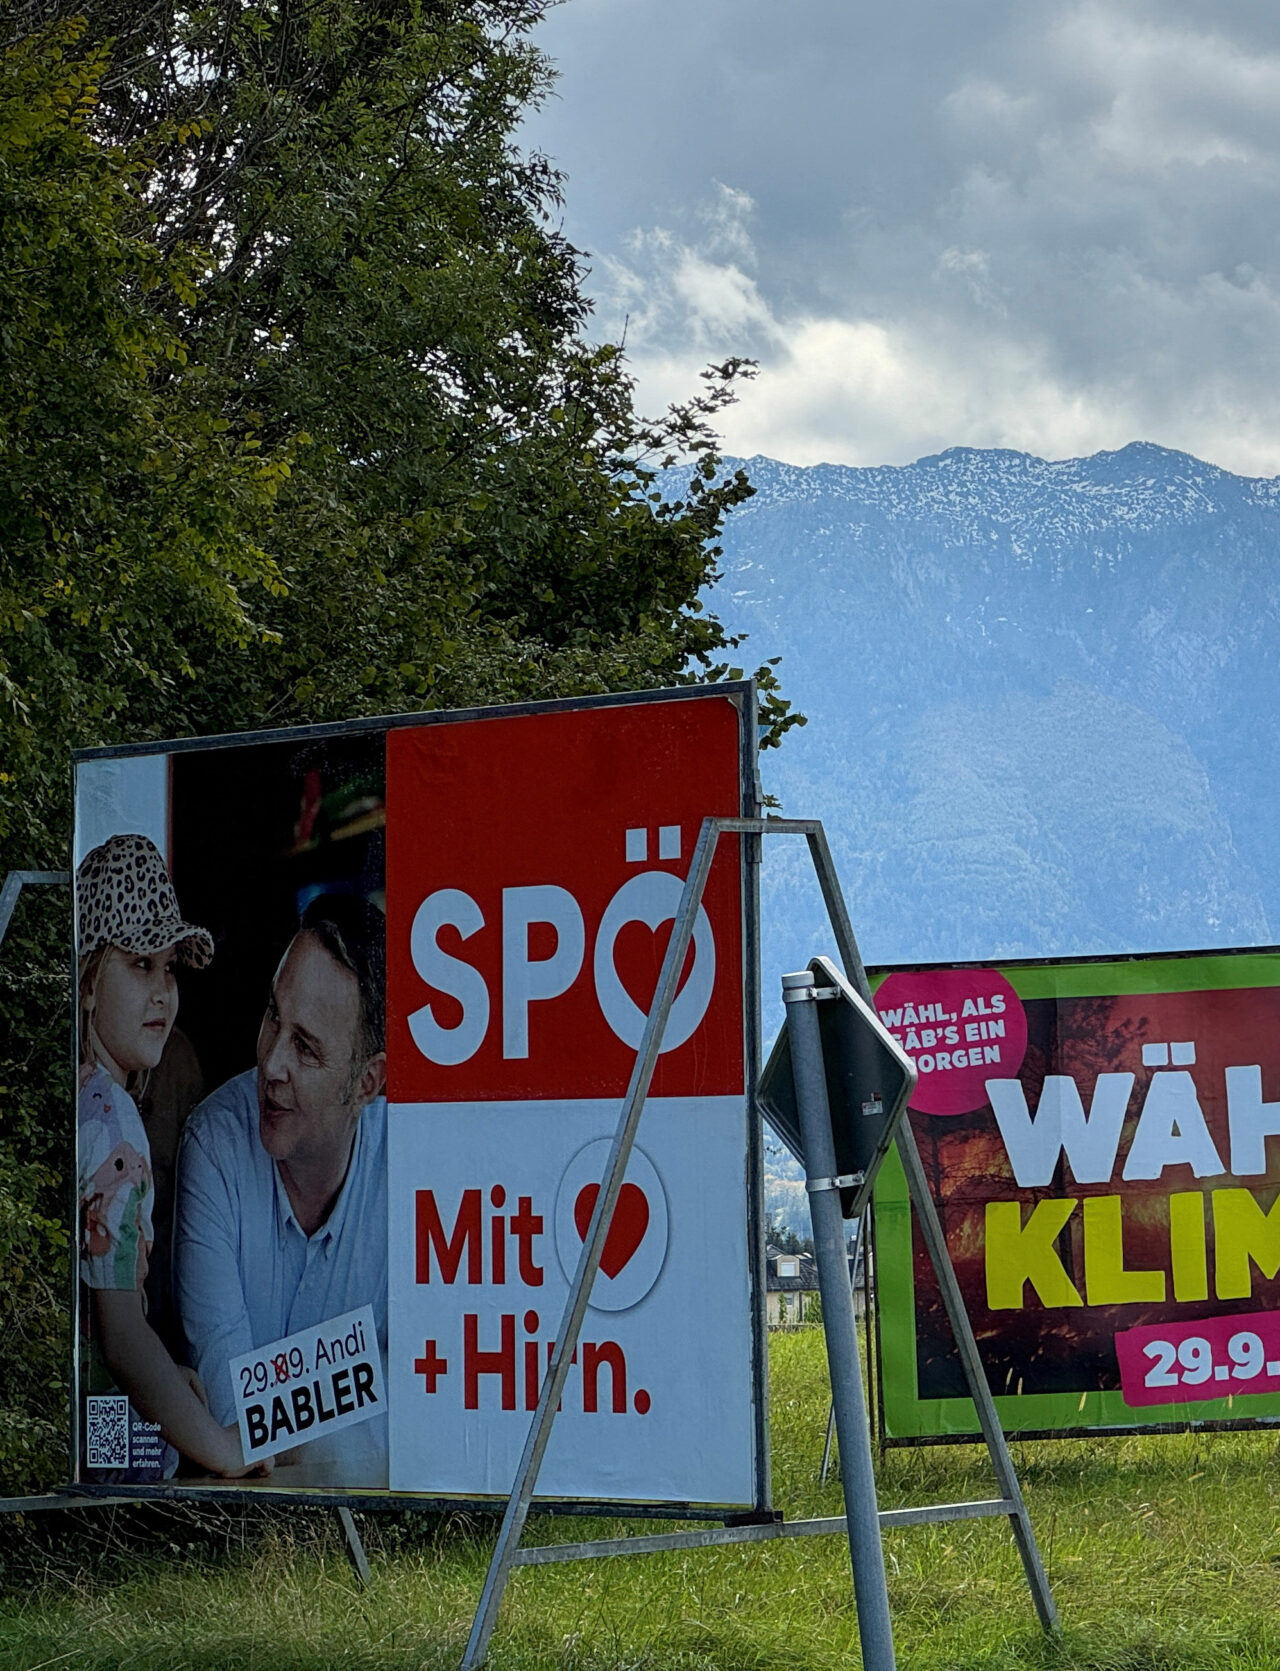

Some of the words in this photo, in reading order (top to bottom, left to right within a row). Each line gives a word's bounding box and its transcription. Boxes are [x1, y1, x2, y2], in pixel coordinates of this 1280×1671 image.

[407, 825, 716, 1066] SPÖ
[880, 1002, 957, 1028] WÄHL,
[961, 995, 1006, 1018] ALS
[965, 1019, 1006, 1042] EIN
[911, 1045, 1001, 1073] ORGEN
[415, 1184, 544, 1286] Mit
[315, 1321, 366, 1370] Andi
[1143, 1332, 1280, 1388] 29.9.
[245, 1362, 378, 1450] BABLER
